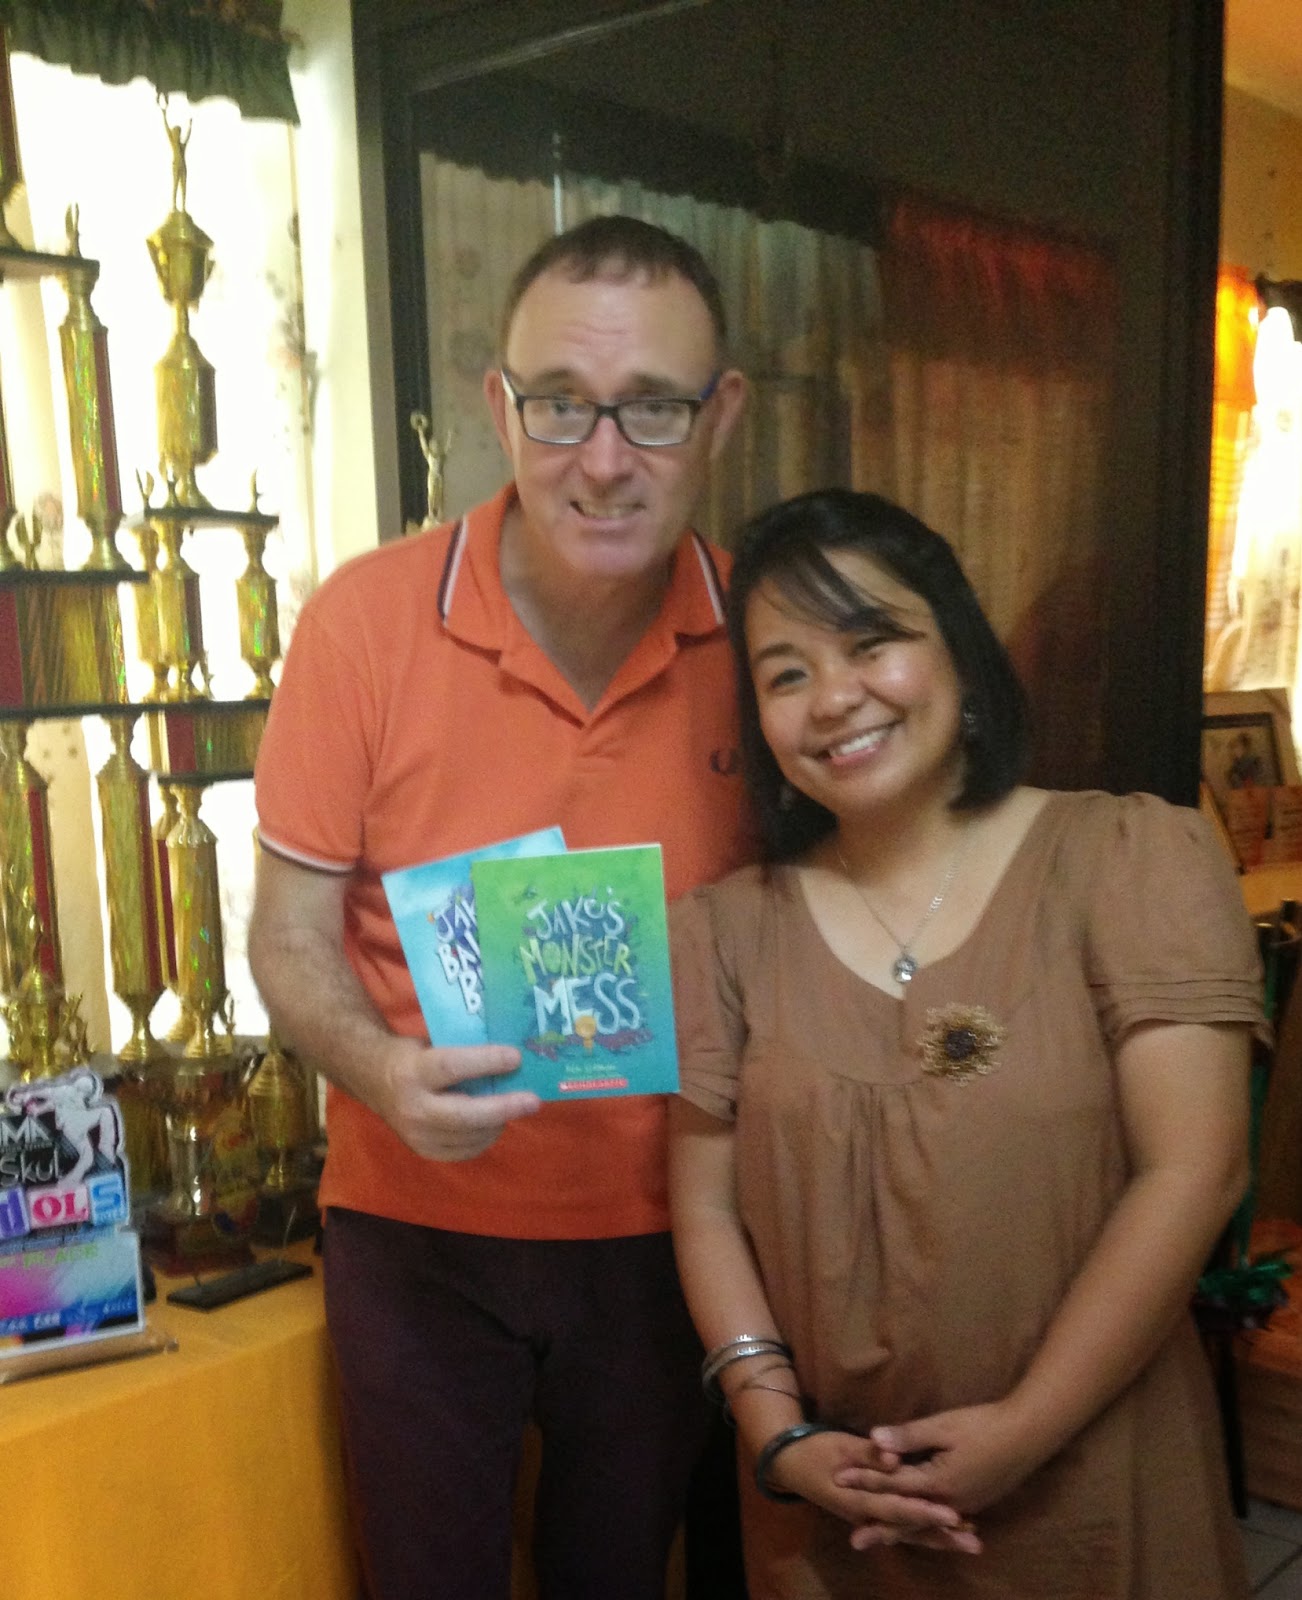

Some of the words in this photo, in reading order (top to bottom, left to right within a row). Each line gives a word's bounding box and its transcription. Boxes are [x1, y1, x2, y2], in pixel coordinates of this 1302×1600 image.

[519, 933, 632, 984] MONSTER
[533, 972, 640, 1036] MESS
[0, 1117, 53, 1149] MA
